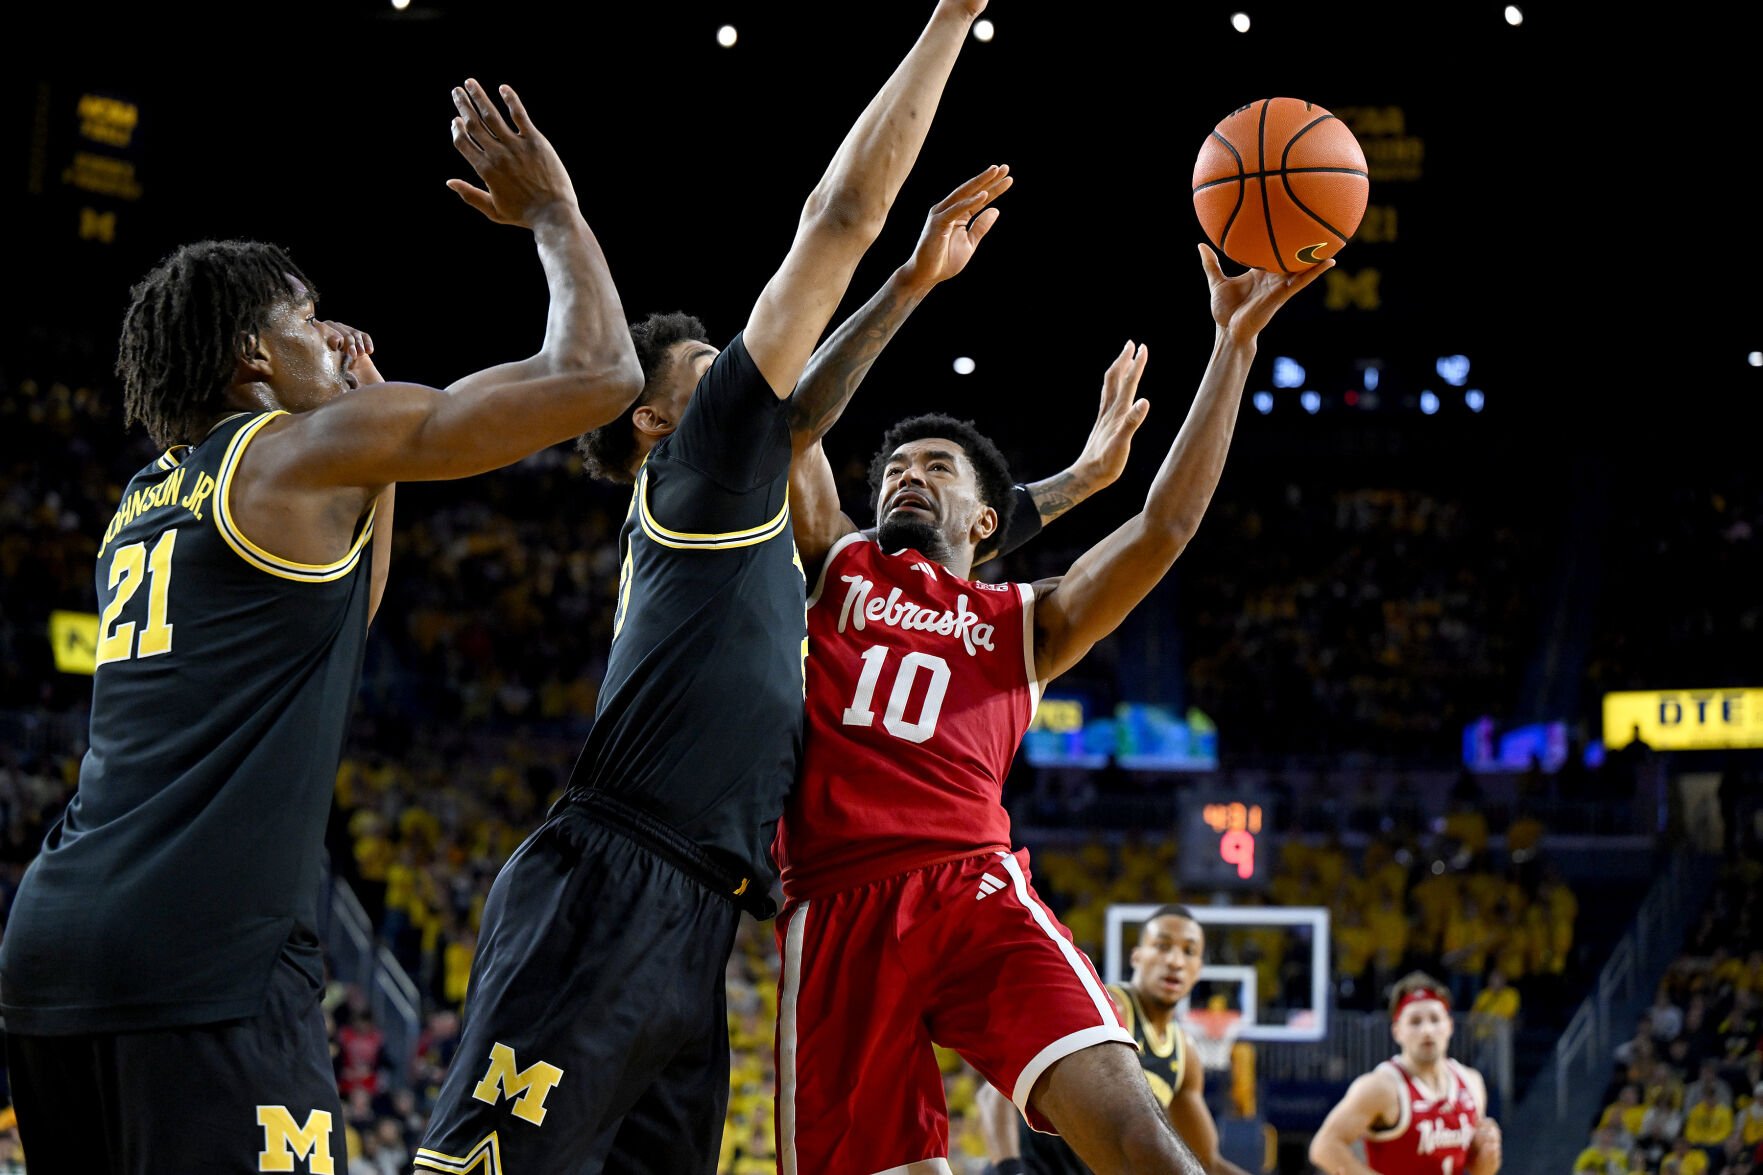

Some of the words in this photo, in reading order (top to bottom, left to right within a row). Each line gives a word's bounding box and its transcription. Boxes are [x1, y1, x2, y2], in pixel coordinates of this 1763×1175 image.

[97, 467, 186, 559] JOHNSON
[96, 528, 178, 668] 21
[837, 574, 995, 657] Nebraska
[842, 644, 952, 744] 10
[472, 1041, 564, 1127] M
[256, 1104, 335, 1175] M
